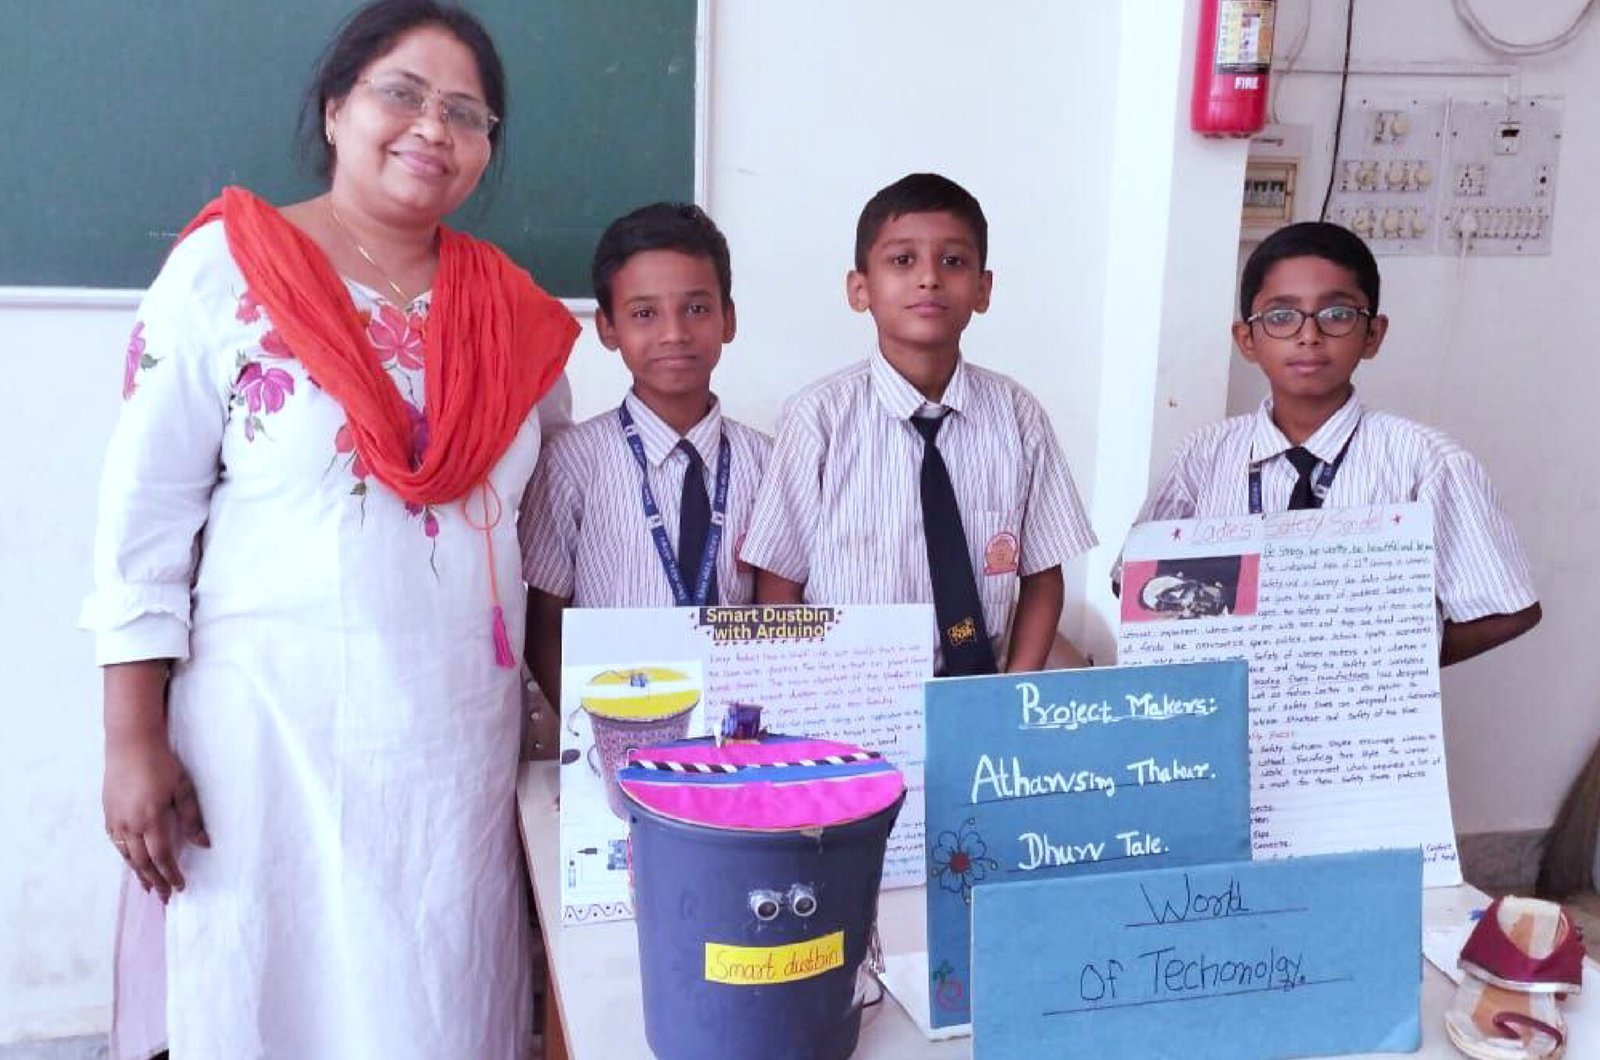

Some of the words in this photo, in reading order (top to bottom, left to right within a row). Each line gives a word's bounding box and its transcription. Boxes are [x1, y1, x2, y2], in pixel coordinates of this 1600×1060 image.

[1234, 77, 1259, 90] FIRE
[707, 608, 759, 623] Smart
[762, 608, 829, 623] Dustbin
[714, 624, 751, 639] with
[757, 623, 824, 639] Arduino
[1016, 682, 1113, 729] Project
[1125, 691, 1218, 719] Makers:
[1116, 830, 1169, 858] Tale.
[710, 949, 776, 979] Smart
[784, 945, 839, 977] dustbin
